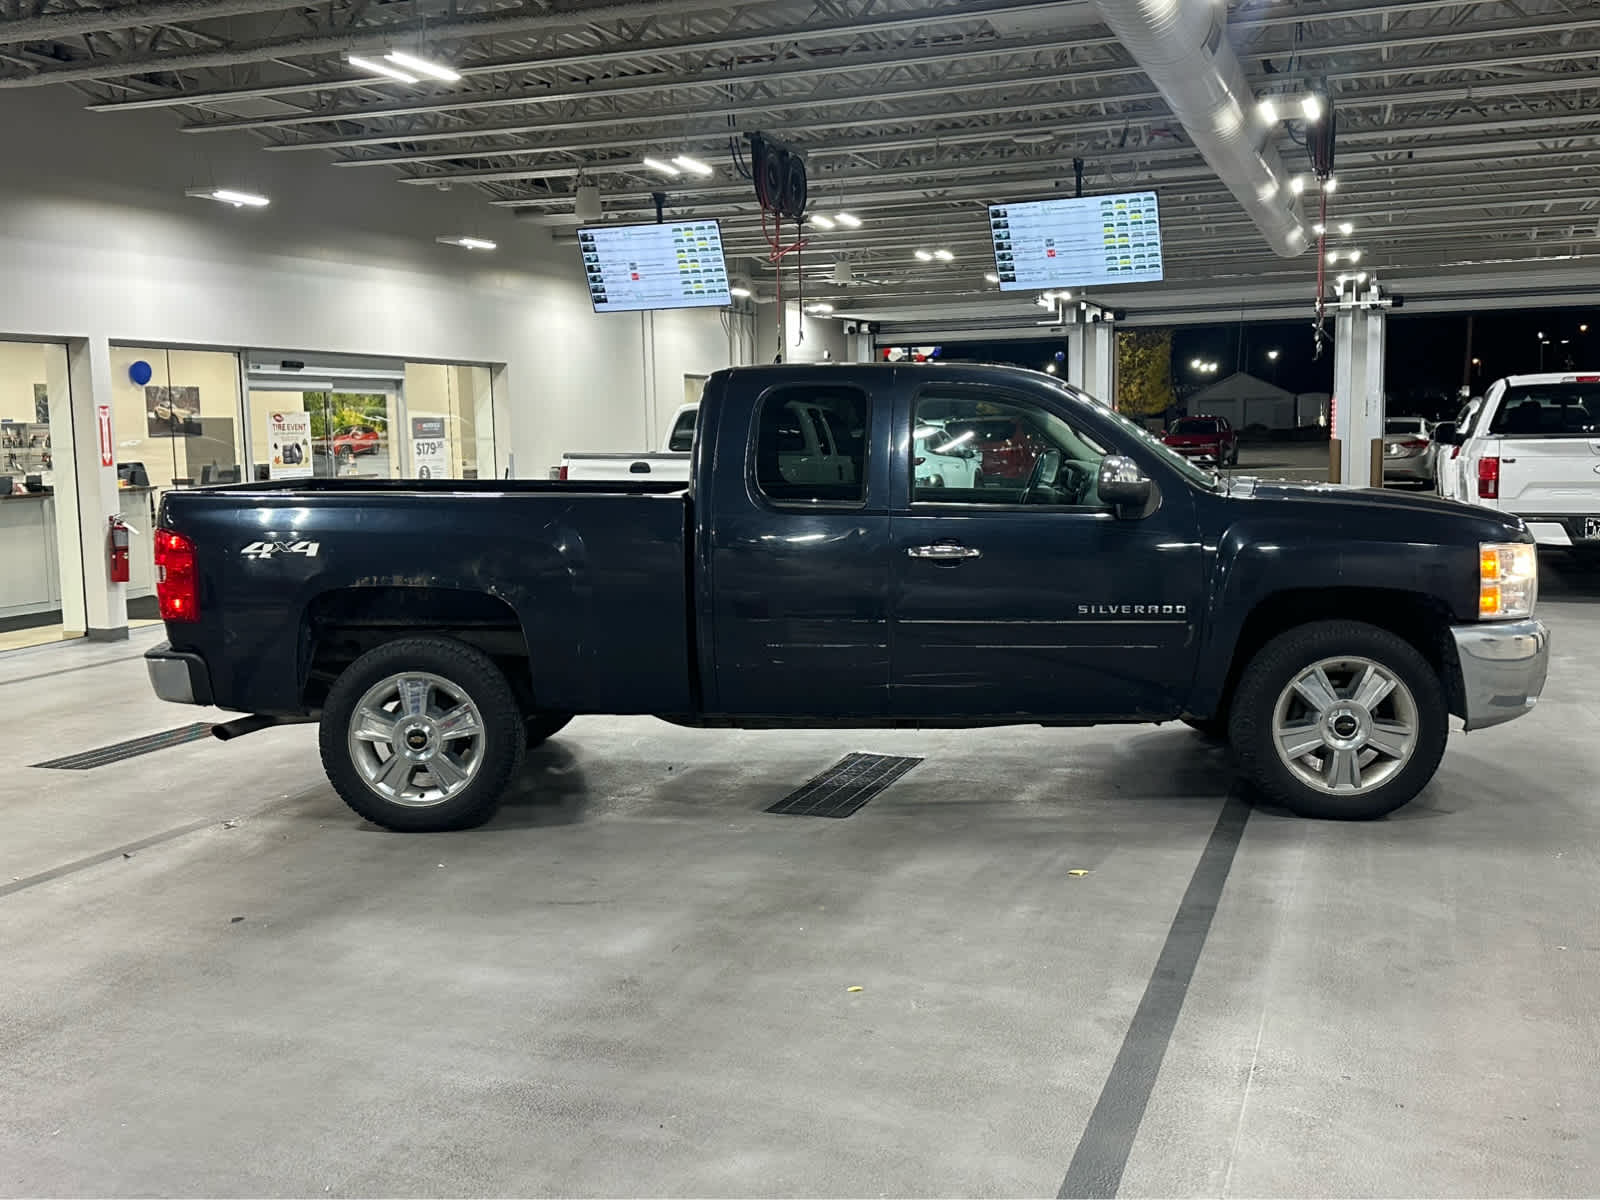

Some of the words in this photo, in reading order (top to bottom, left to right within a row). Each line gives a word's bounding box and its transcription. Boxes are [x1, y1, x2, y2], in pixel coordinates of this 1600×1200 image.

[272, 423, 286, 431] TIRE
[287, 423, 306, 431] EVENT
[1077, 604, 1187, 614] SILVERADO
